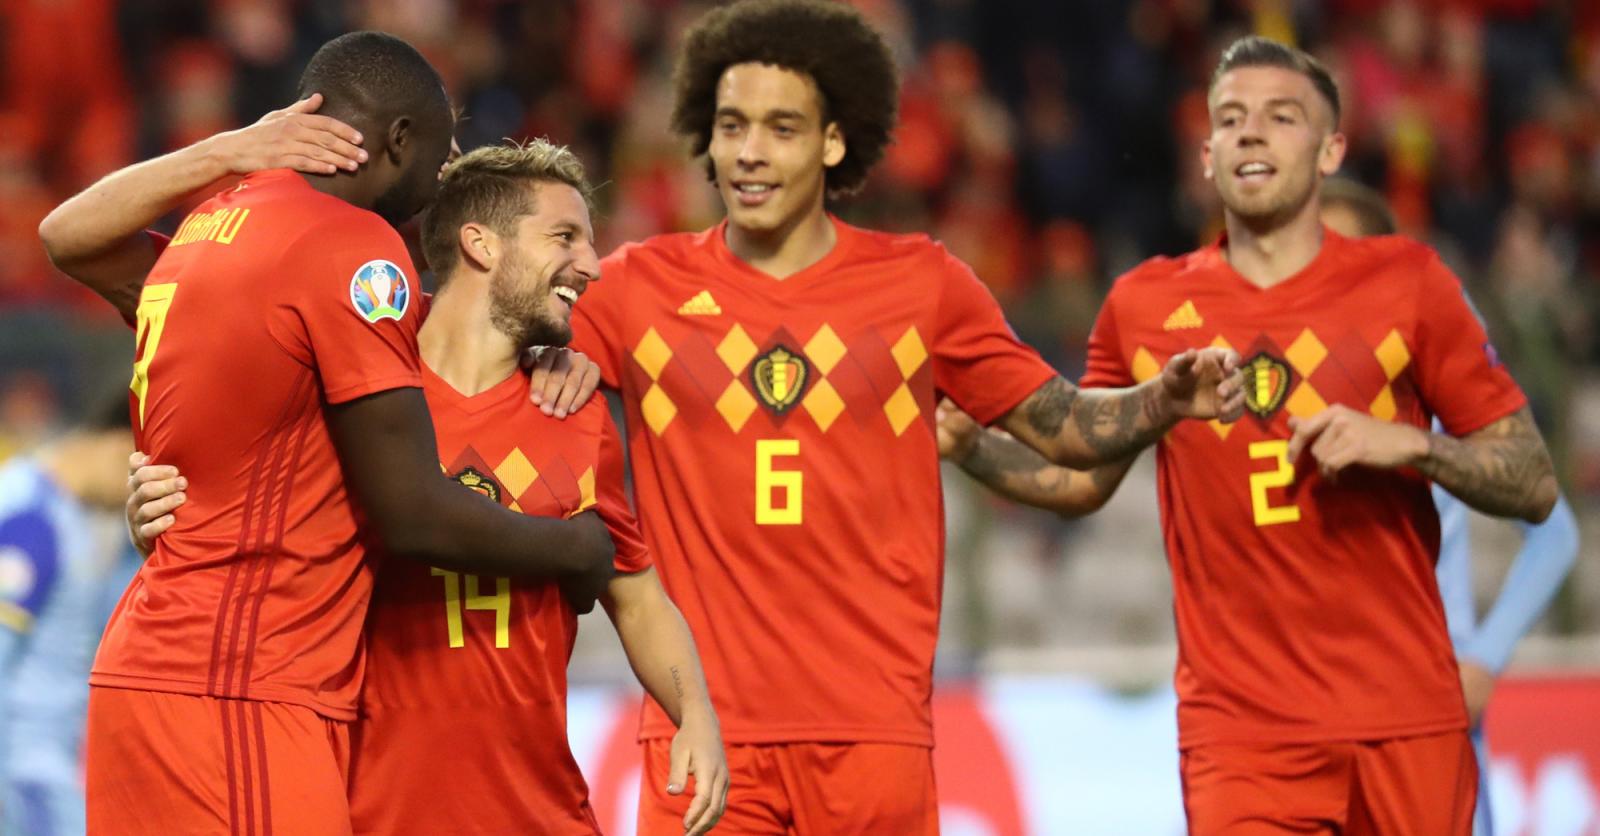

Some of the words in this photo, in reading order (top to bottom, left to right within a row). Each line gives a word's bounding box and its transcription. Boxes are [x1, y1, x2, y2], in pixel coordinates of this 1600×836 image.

[755, 439, 803, 525] 6
[1249, 439, 1301, 527] 2
[430, 565, 511, 649] 14
